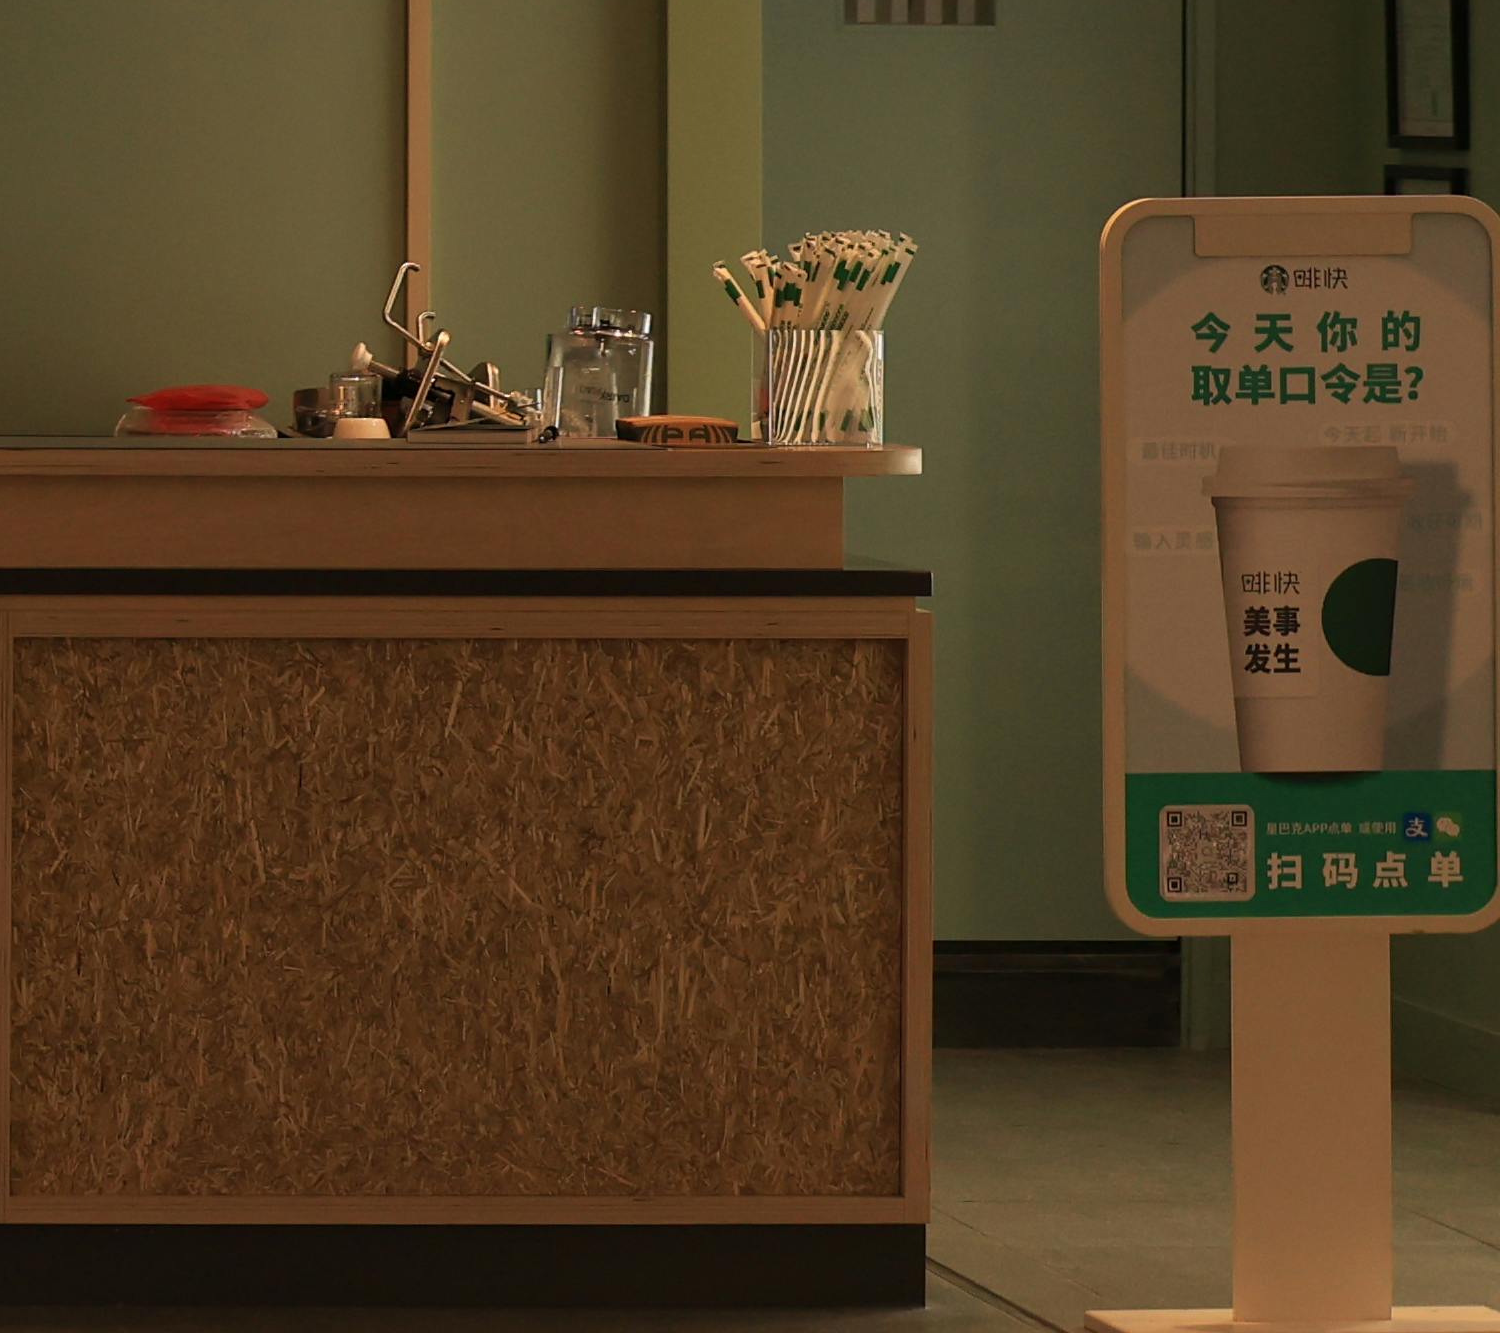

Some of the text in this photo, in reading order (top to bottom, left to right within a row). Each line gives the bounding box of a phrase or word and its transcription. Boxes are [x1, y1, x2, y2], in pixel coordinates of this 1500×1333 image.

[1191, 311, 1421, 354] 今天你的
[1243, 607, 1301, 637] 美事
[1243, 644, 1301, 674] 发生
[1267, 851, 1463, 889] 扫码点单
